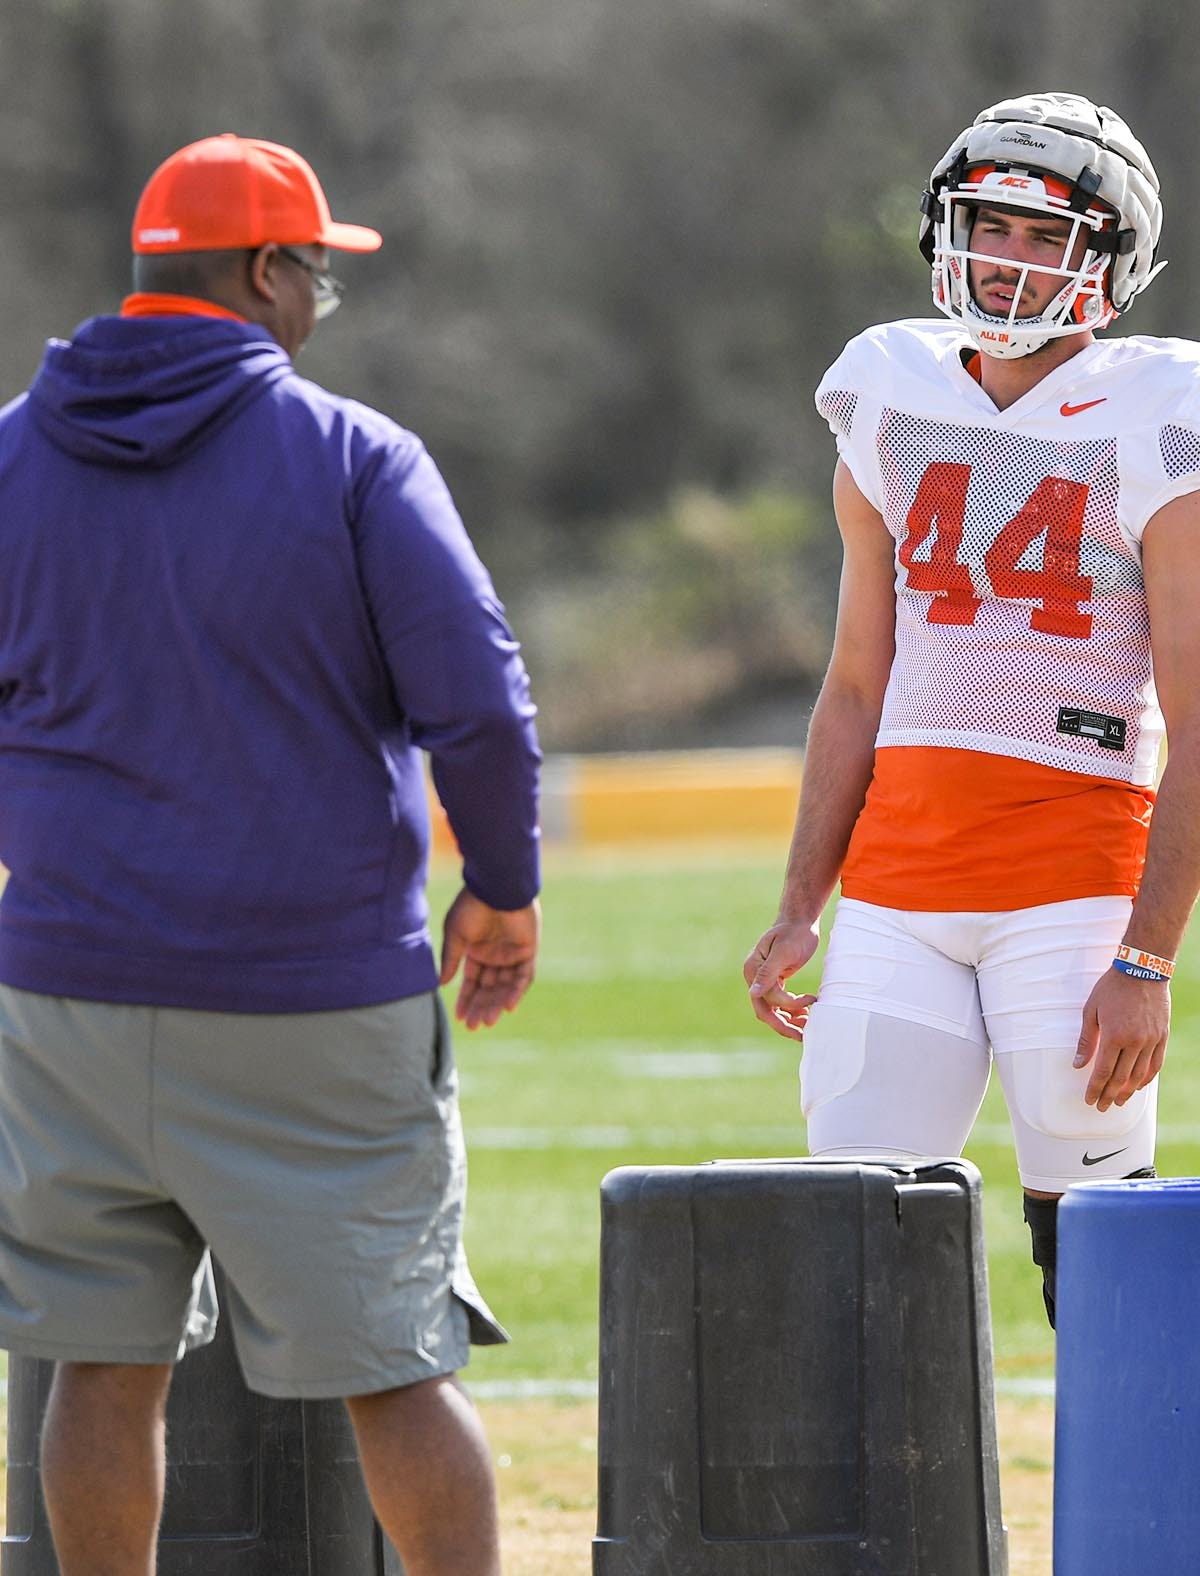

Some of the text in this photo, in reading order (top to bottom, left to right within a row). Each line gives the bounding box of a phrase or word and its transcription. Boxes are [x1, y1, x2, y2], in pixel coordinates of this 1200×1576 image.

[1000, 136, 1047, 149] GUARDIAN
[998, 176, 1032, 189] ACC
[980, 330, 1009, 343] ALL IN
[899, 461, 1094, 640] 44
[1109, 724, 1121, 737] XL
[1125, 967, 1162, 980] TRUMP
